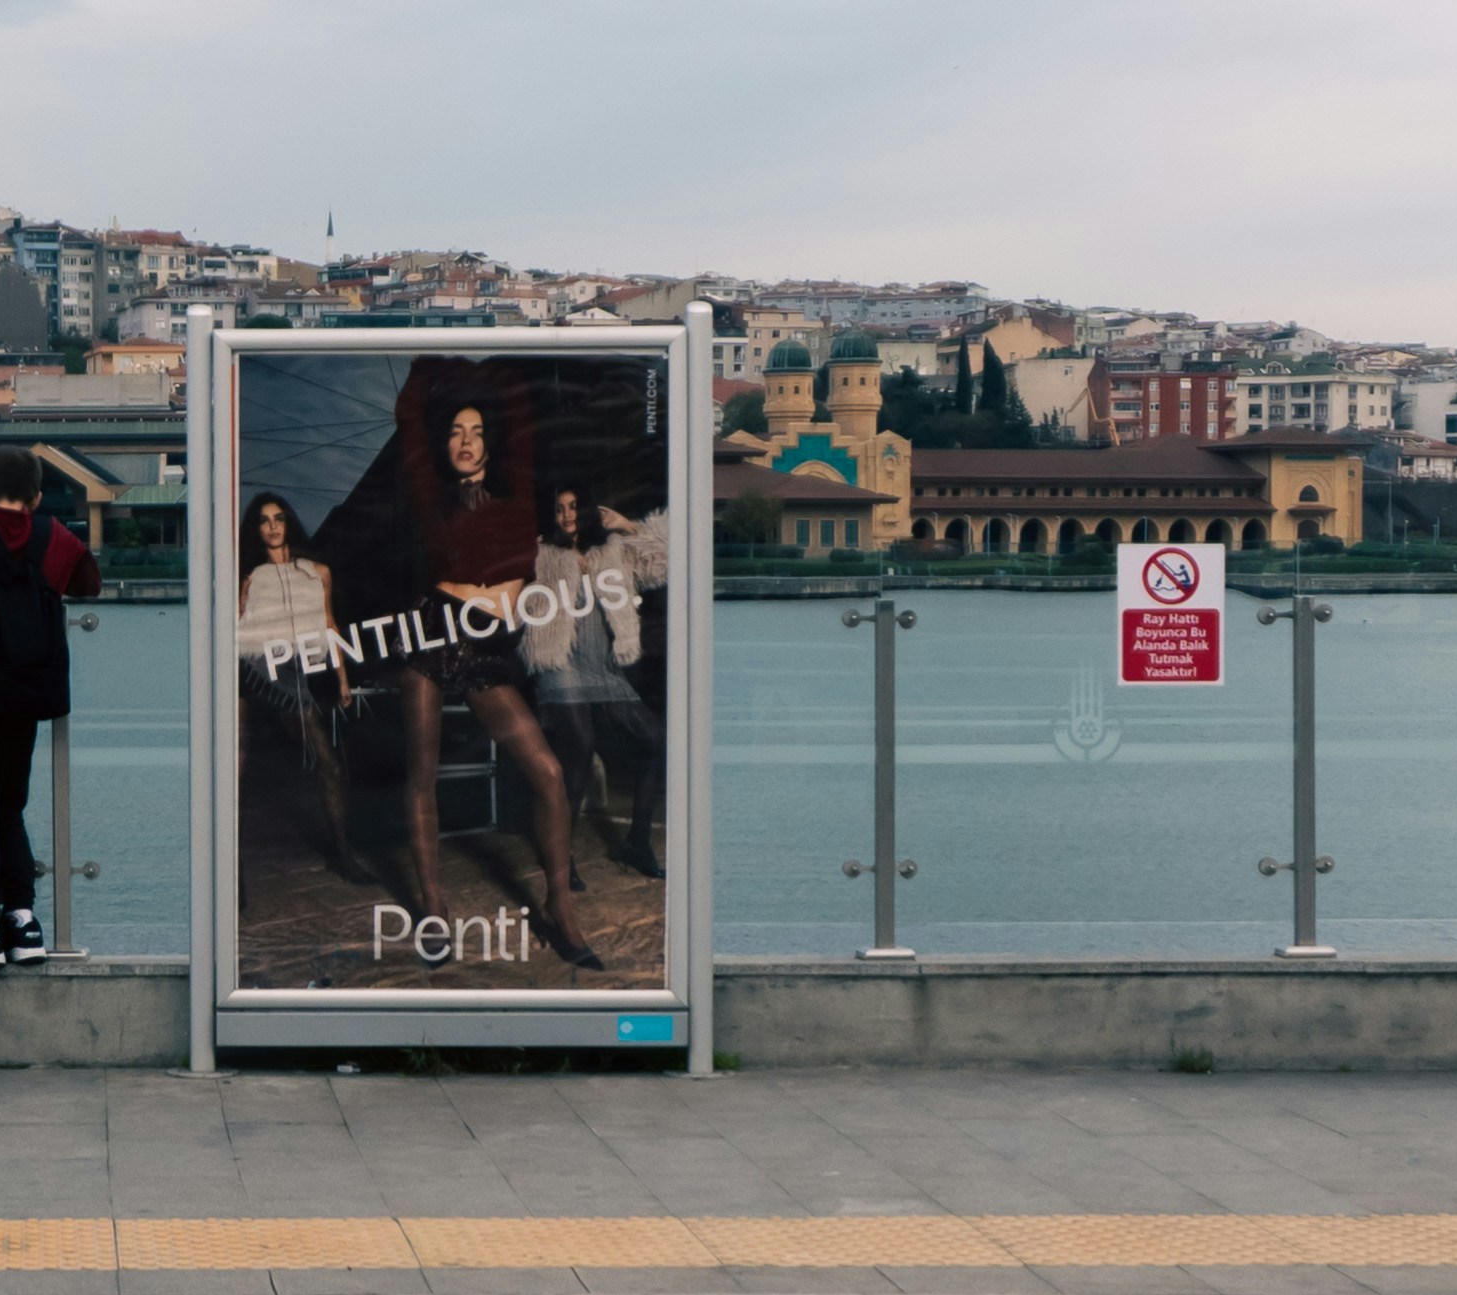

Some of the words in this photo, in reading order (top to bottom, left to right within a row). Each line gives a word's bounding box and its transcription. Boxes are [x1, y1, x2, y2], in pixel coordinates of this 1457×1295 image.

[646, 368, 658, 433] PENTI.COM
[263, 568, 644, 682] PENTILICIOUS.
[1143, 613, 1166, 626] Ray
[1169, 613, 1199, 624] Hattı
[1136, 627, 1188, 640] Boyunca
[1190, 627, 1207, 638] Bu
[1133, 639, 1177, 651] Alanda
[1179, 639, 1210, 651] Balık
[1148, 652, 1194, 664] Tutmak
[1144, 666, 1198, 677] Yasaktır!
[373, 904, 530, 962] Penti
